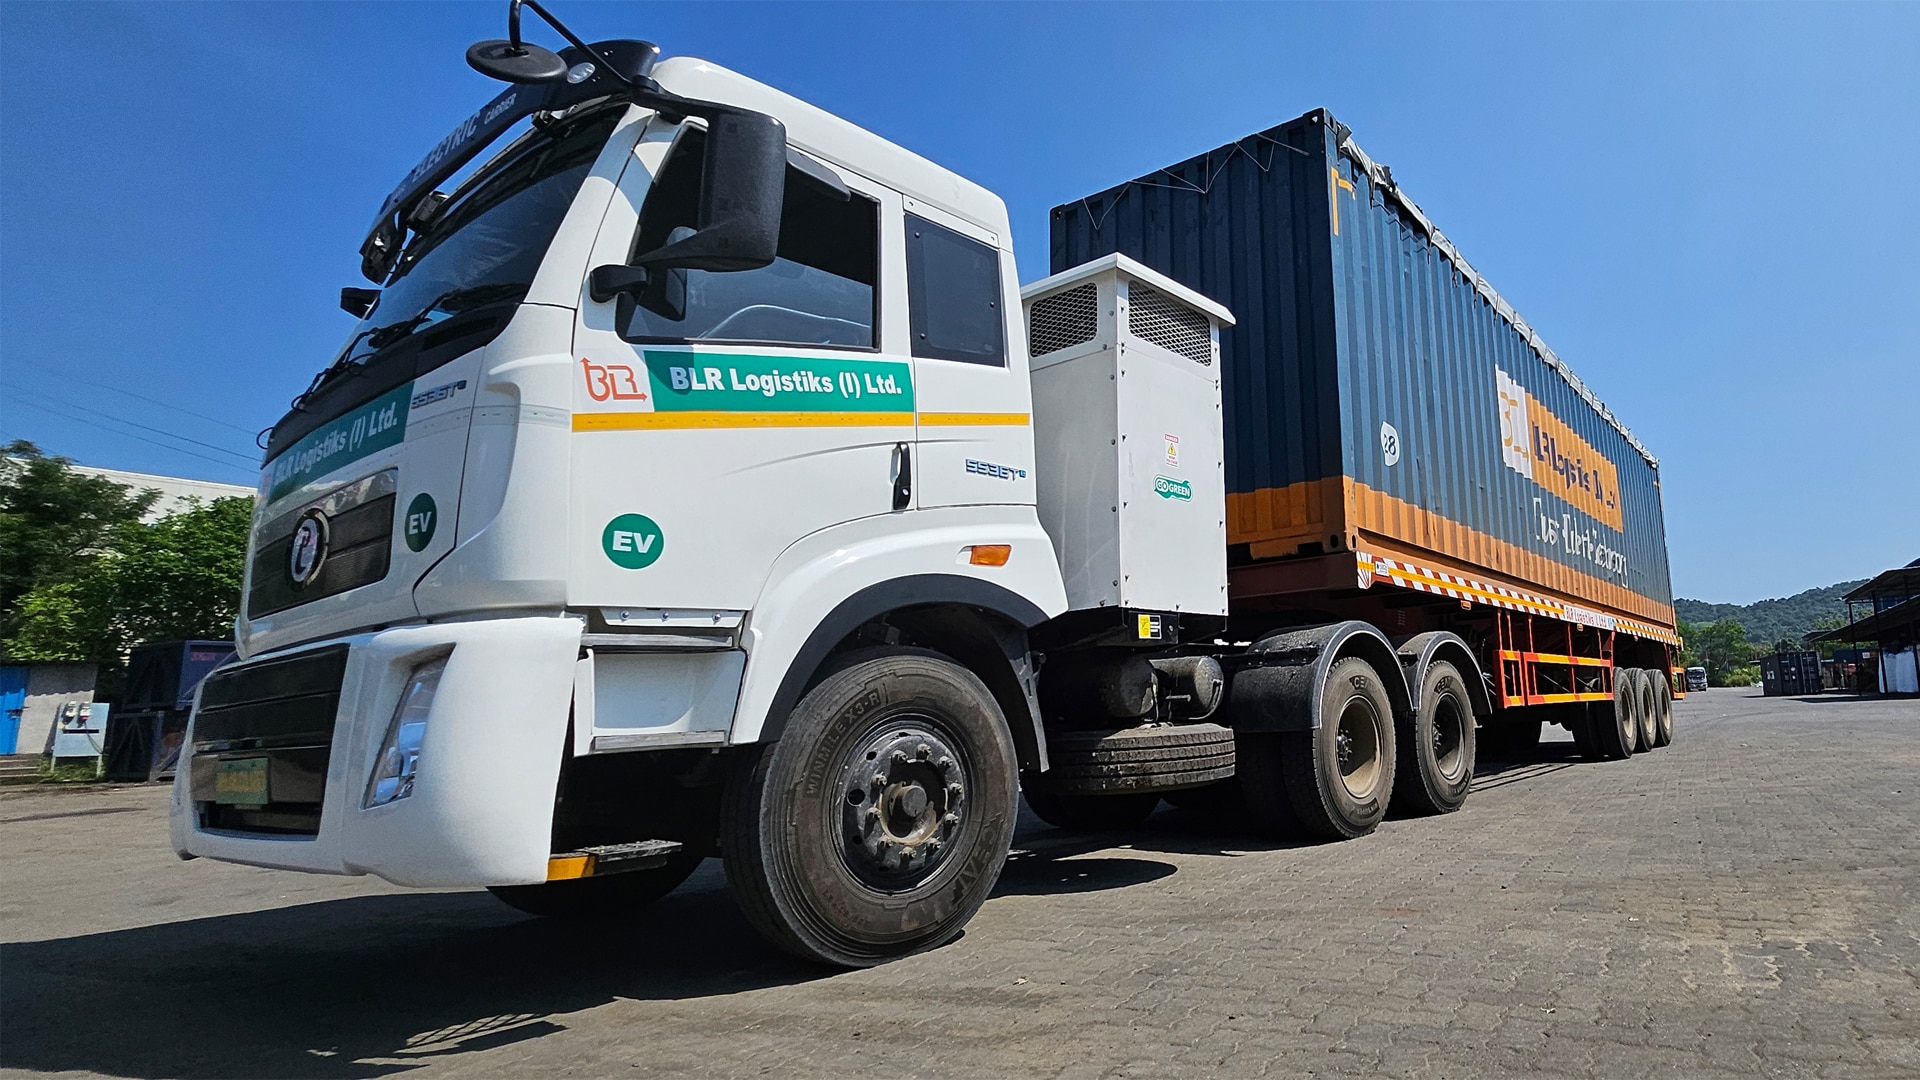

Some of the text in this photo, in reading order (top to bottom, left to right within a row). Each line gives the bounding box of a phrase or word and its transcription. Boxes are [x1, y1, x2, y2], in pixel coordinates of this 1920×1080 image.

[670, 366, 902, 399] BLR Logistiks (I) Ltd.
[293, 430, 347, 474] Logistiks
[368, 401, 398, 437] Ltd.
[1157, 480, 1190, 497] GO GREEN
[408, 511, 432, 535] EV
[612, 530, 656, 553] EV
[805, 692, 882, 797] WINMILE X3-R
